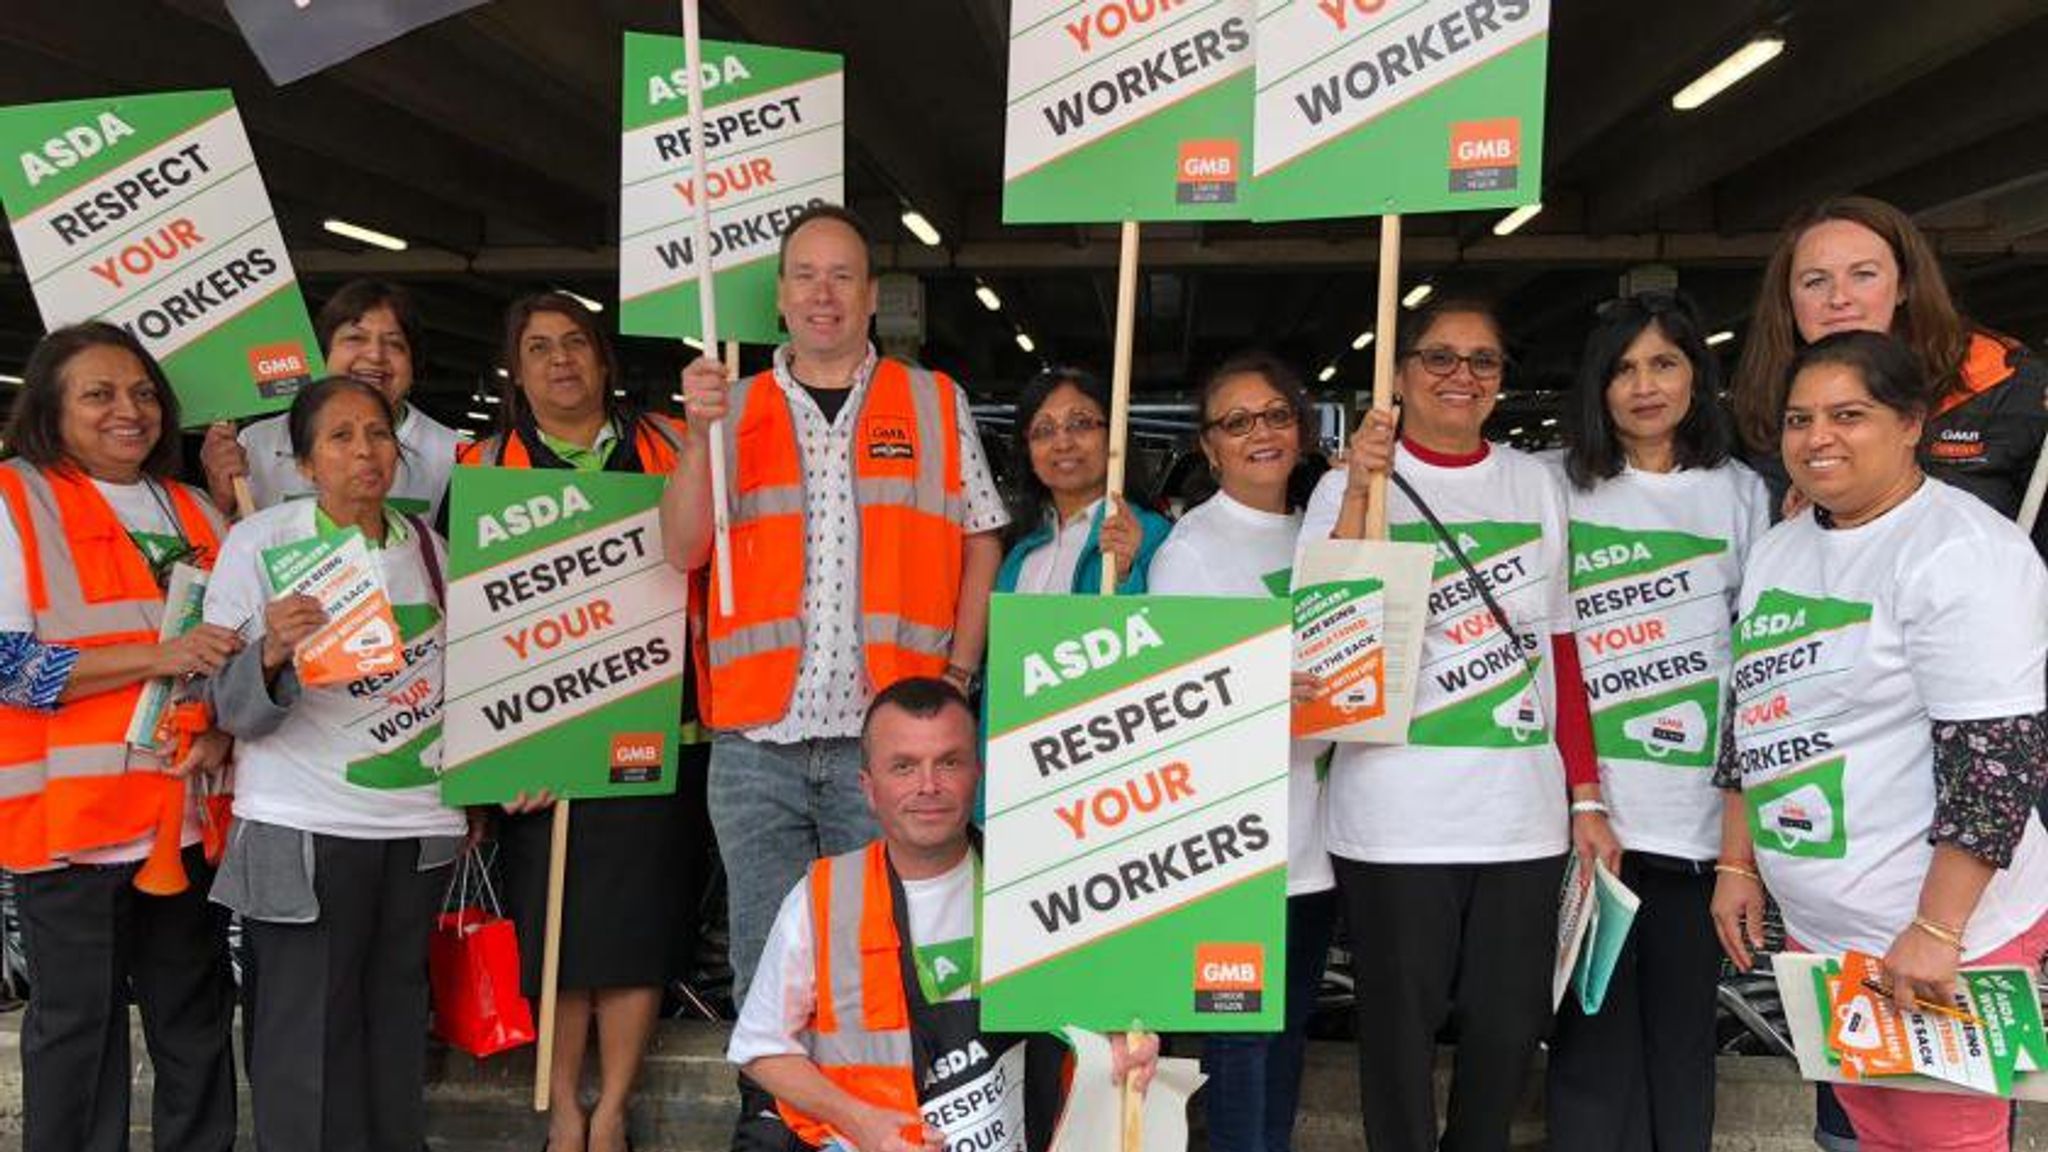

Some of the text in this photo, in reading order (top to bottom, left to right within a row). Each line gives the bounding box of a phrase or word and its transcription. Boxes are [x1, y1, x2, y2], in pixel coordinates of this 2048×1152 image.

[1043, 17, 1250, 136] WORKERS
[1295, 0, 1530, 125] WORKERS
[20, 112, 136, 186] ASDA
[1184, 157, 1231, 175] GMB
[1458, 139, 1511, 160] GMB
[50, 144, 211, 245] RESPECT
[674, 157, 777, 207] YOUR
[90, 218, 205, 289] YOUR
[258, 355, 302, 375] GMB
[477, 485, 592, 548] ASDA
[483, 527, 646, 612] RESPECT
[1575, 542, 1652, 576] ASDA
[1575, 570, 1691, 620] RESPECT
[504, 600, 615, 660] YOUR
[1587, 619, 1666, 656] YOUR
[1741, 609, 1806, 642] ASDA
[1024, 614, 1163, 696] ASDA
[1437, 633, 1538, 693] WORKS
[1735, 641, 1823, 691] RESPECT
[482, 638, 672, 731] WORKERS
[1029, 667, 1236, 777] RESPECT
[617, 746, 656, 761] GMB
[1740, 731, 1834, 774] ORKERS
[1054, 761, 1195, 840] YOUR
[1030, 814, 1270, 934] WORKERS
[1203, 962, 1256, 983] GMB
[924, 1039, 989, 1089] ASDA
[949, 1119, 1006, 1152] OUR
